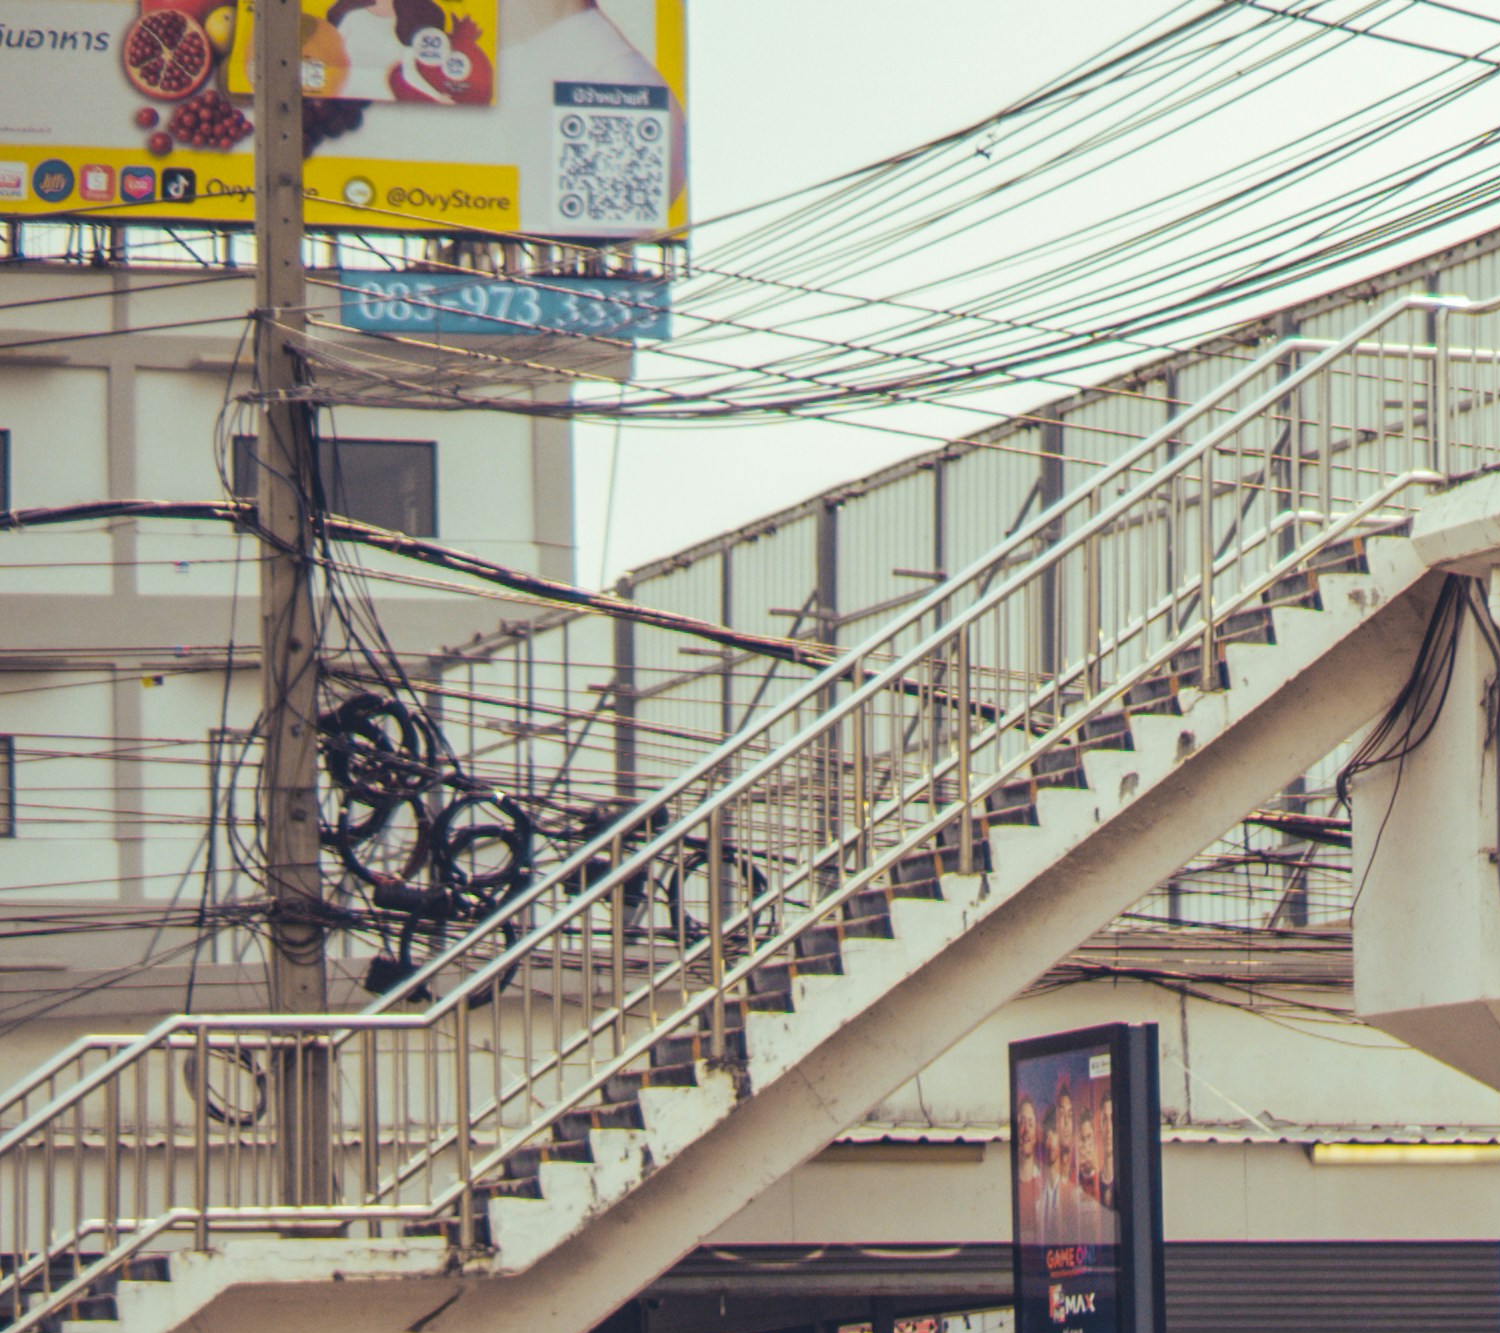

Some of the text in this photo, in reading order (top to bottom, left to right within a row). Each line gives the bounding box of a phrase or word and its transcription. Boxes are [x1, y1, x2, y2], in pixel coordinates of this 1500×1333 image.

[387, 187, 511, 211] @OvyStore
[359, 281, 542, 325] 085-973
[1046, 1247, 1075, 1269] GAME
